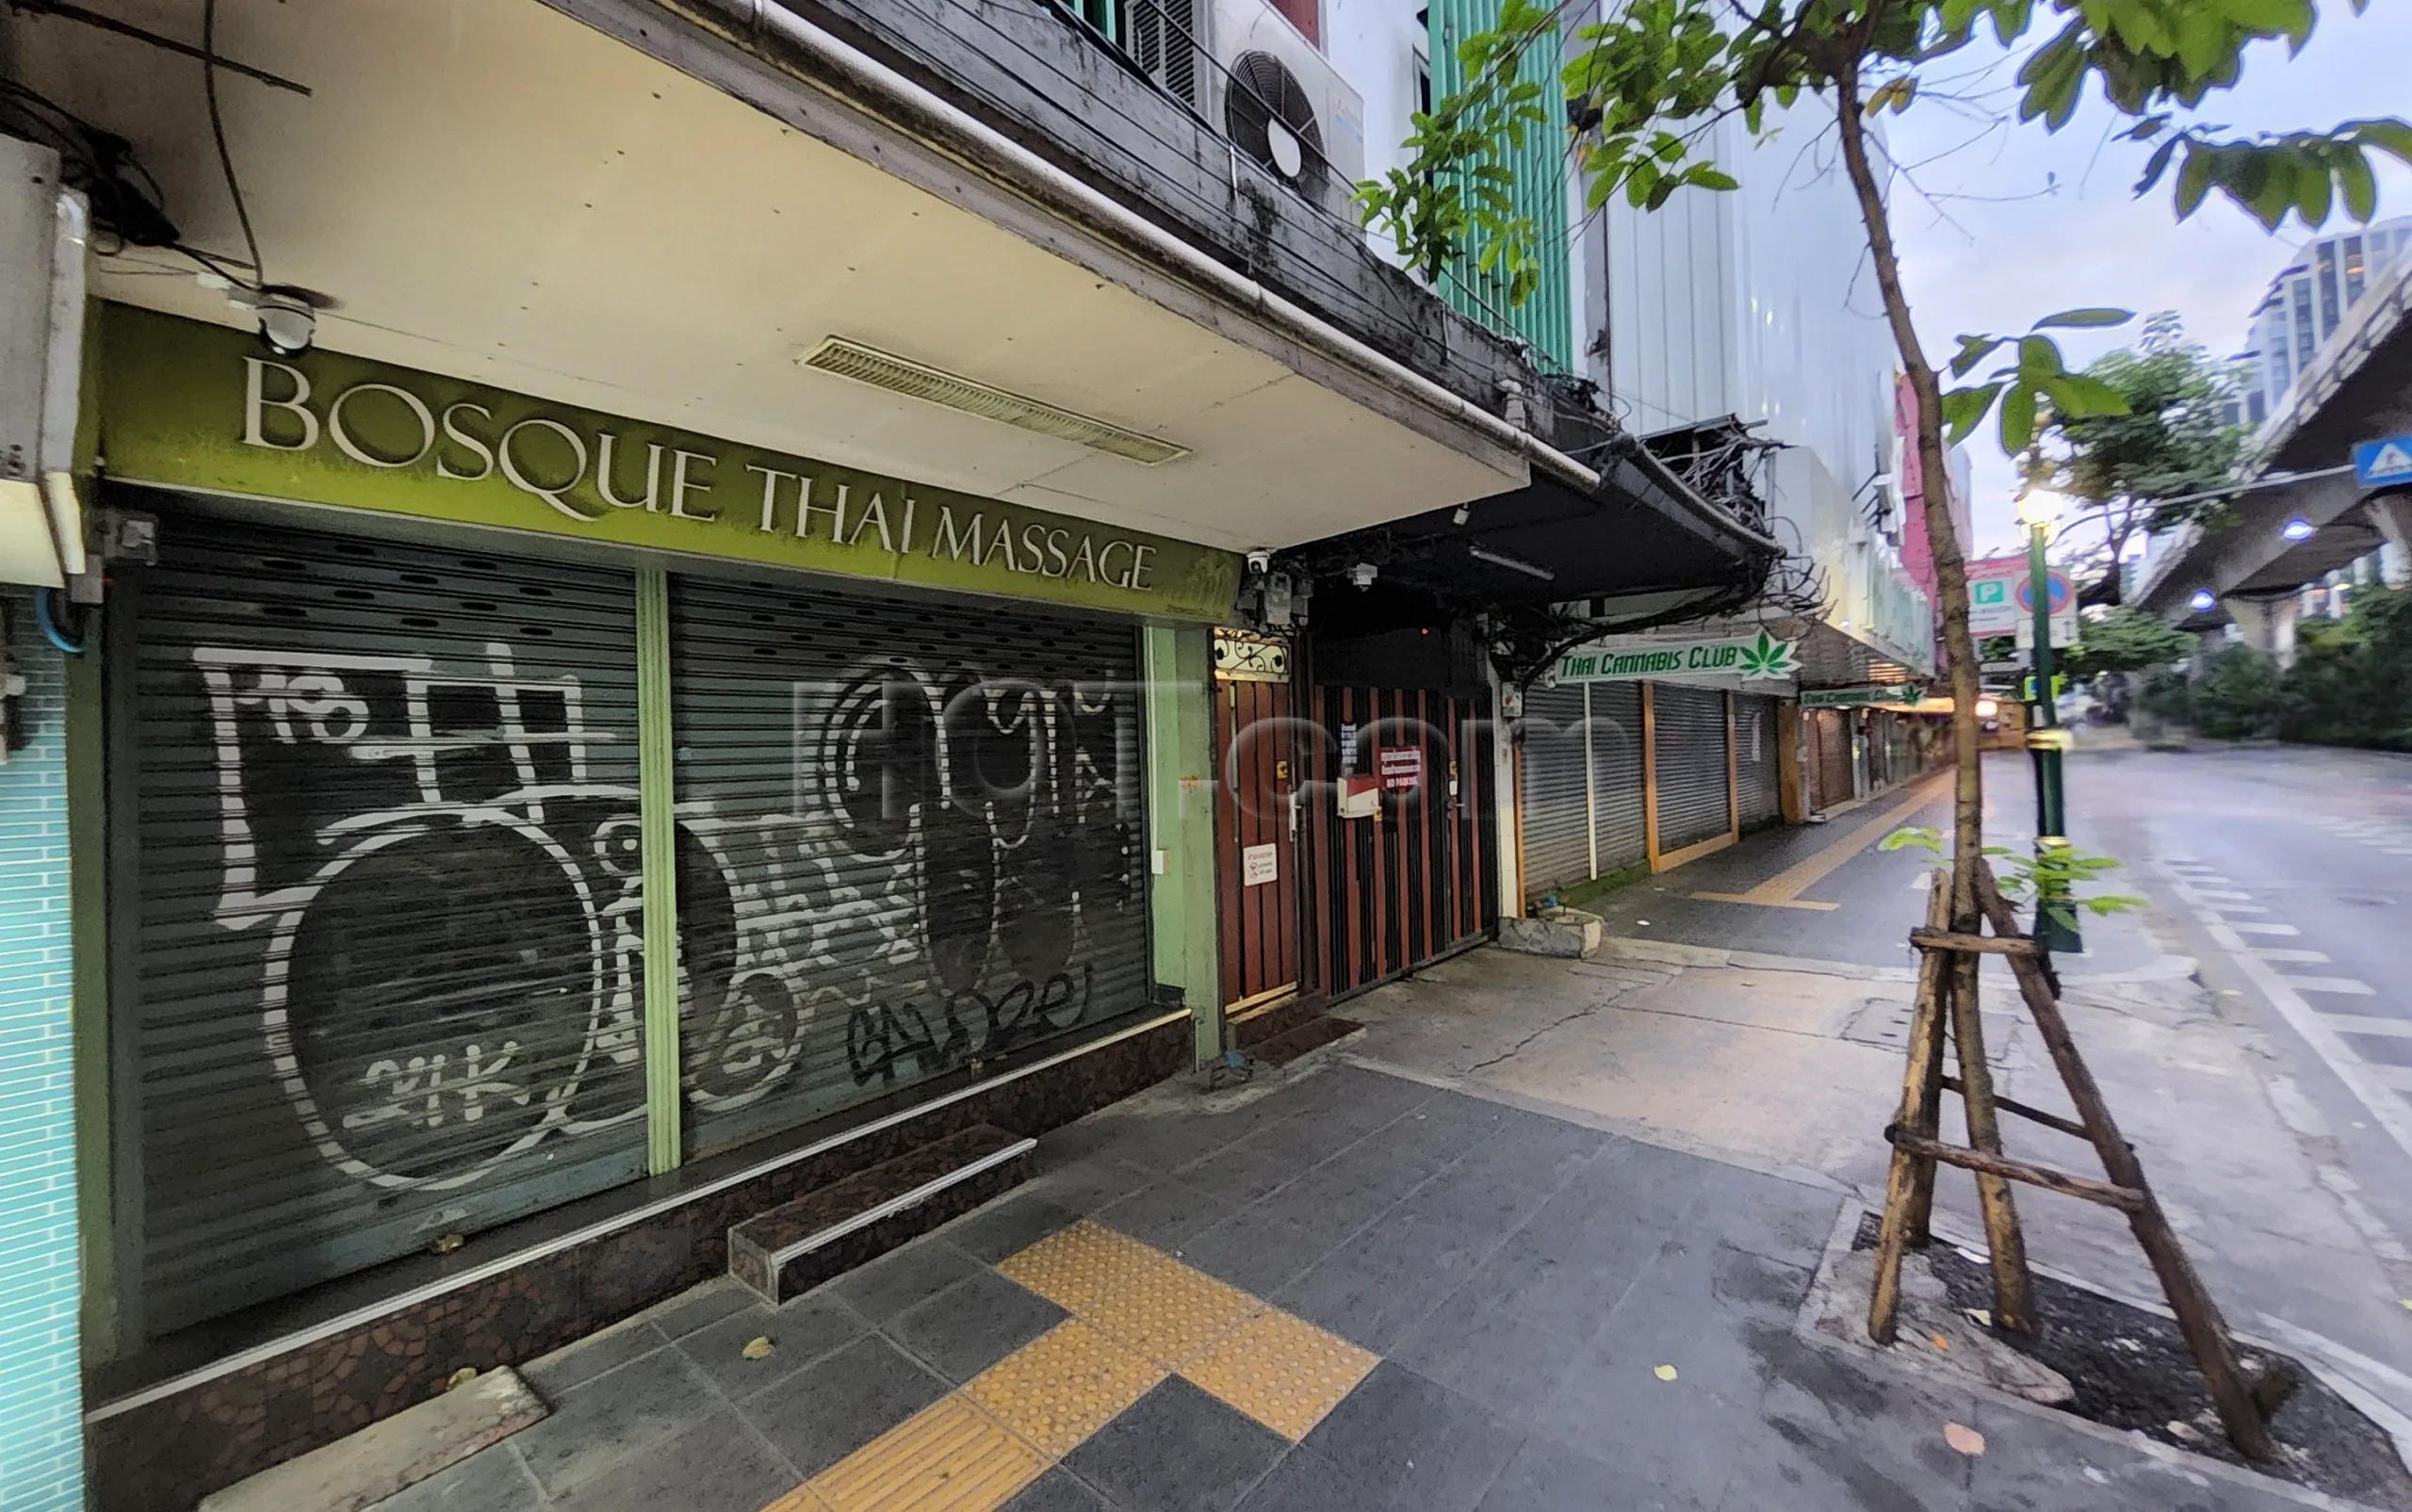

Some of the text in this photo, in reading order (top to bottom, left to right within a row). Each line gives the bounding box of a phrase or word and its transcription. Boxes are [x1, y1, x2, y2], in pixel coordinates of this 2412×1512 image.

[241, 355, 1159, 592] BOSQUE THAI MASSAGE
[1562, 645, 1737, 677] THAI CANNABIS CLUB
